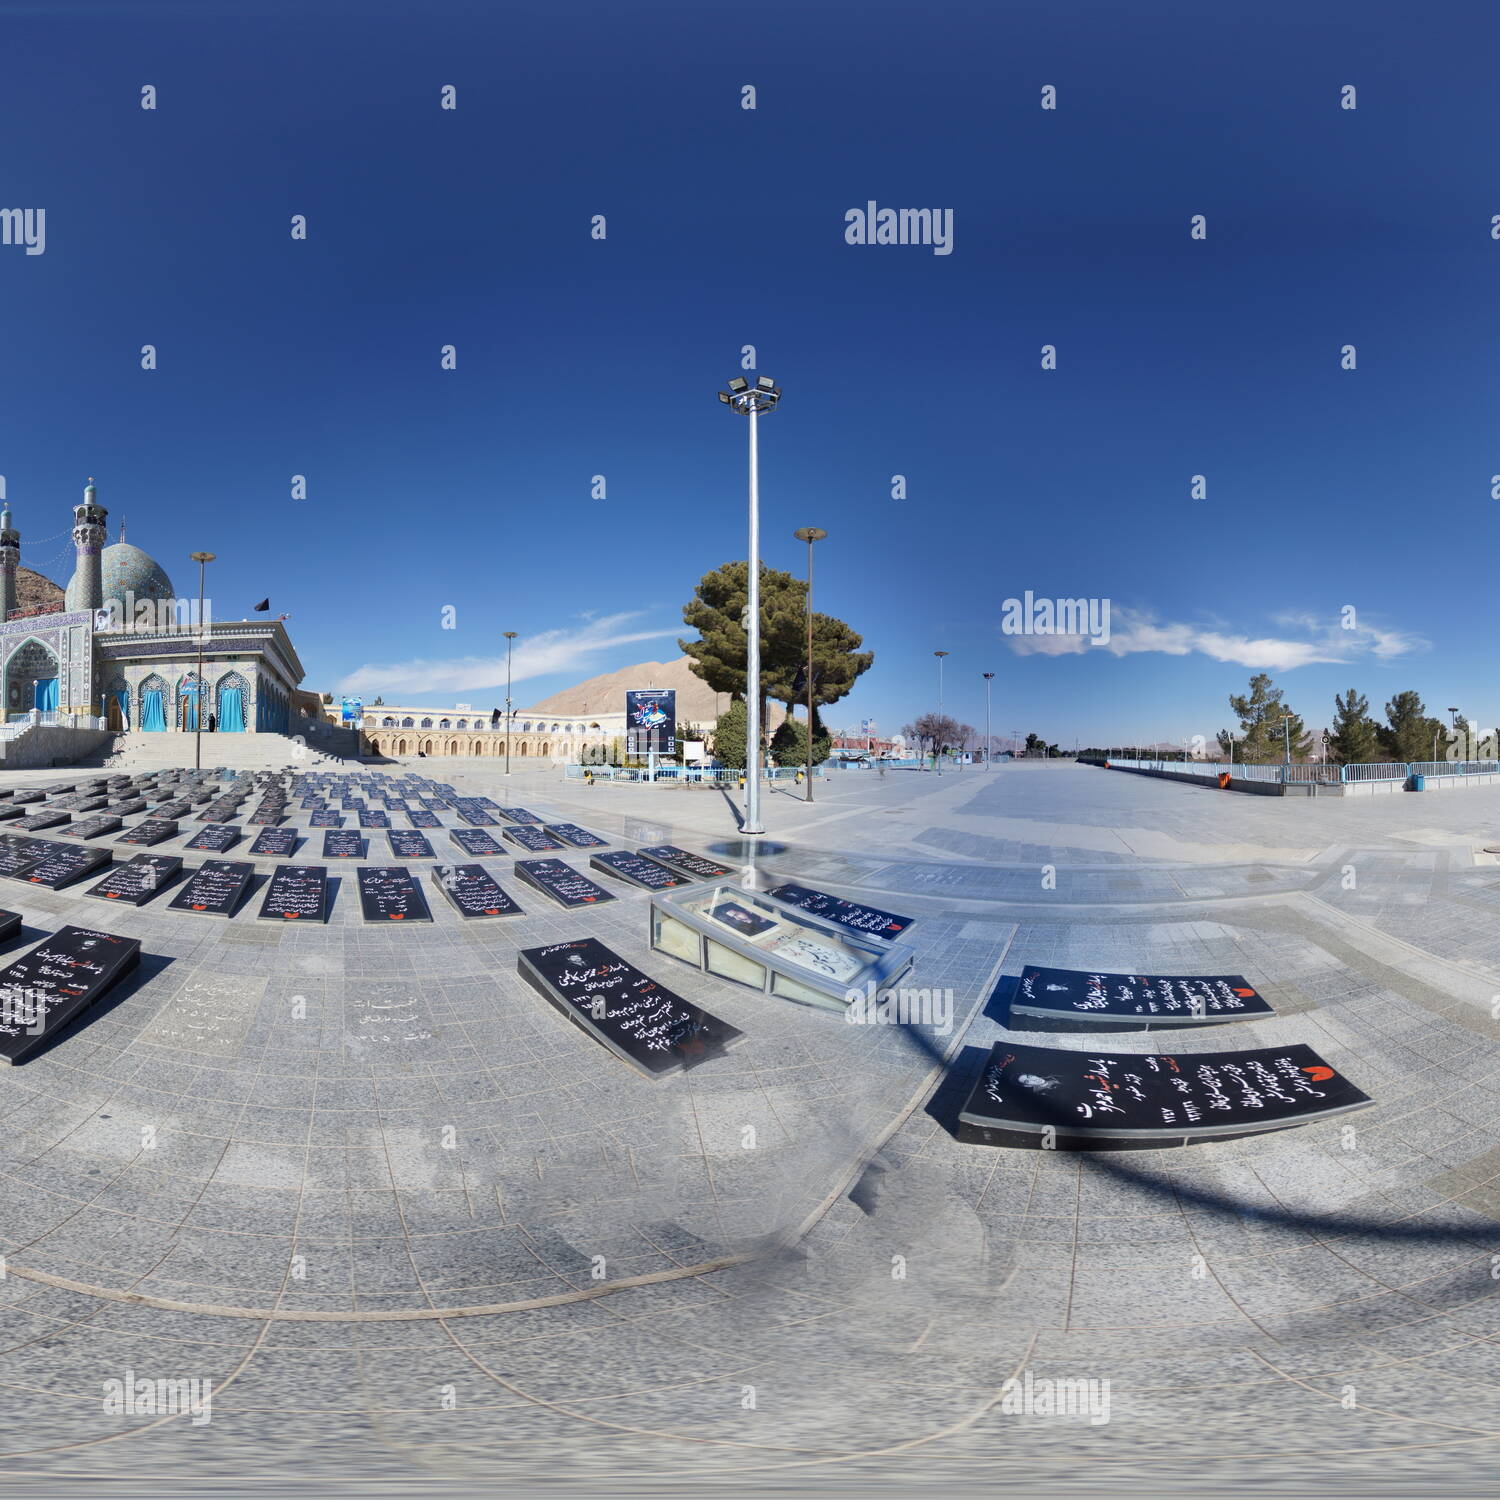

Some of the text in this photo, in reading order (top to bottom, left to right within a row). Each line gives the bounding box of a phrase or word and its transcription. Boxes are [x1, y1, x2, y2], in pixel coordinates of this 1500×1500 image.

[1088, 1060, 1117, 1079] پاسدار
[1145, 1056, 1160, 1072] ولادت
[1083, 1074, 1120, 1092] شهید
